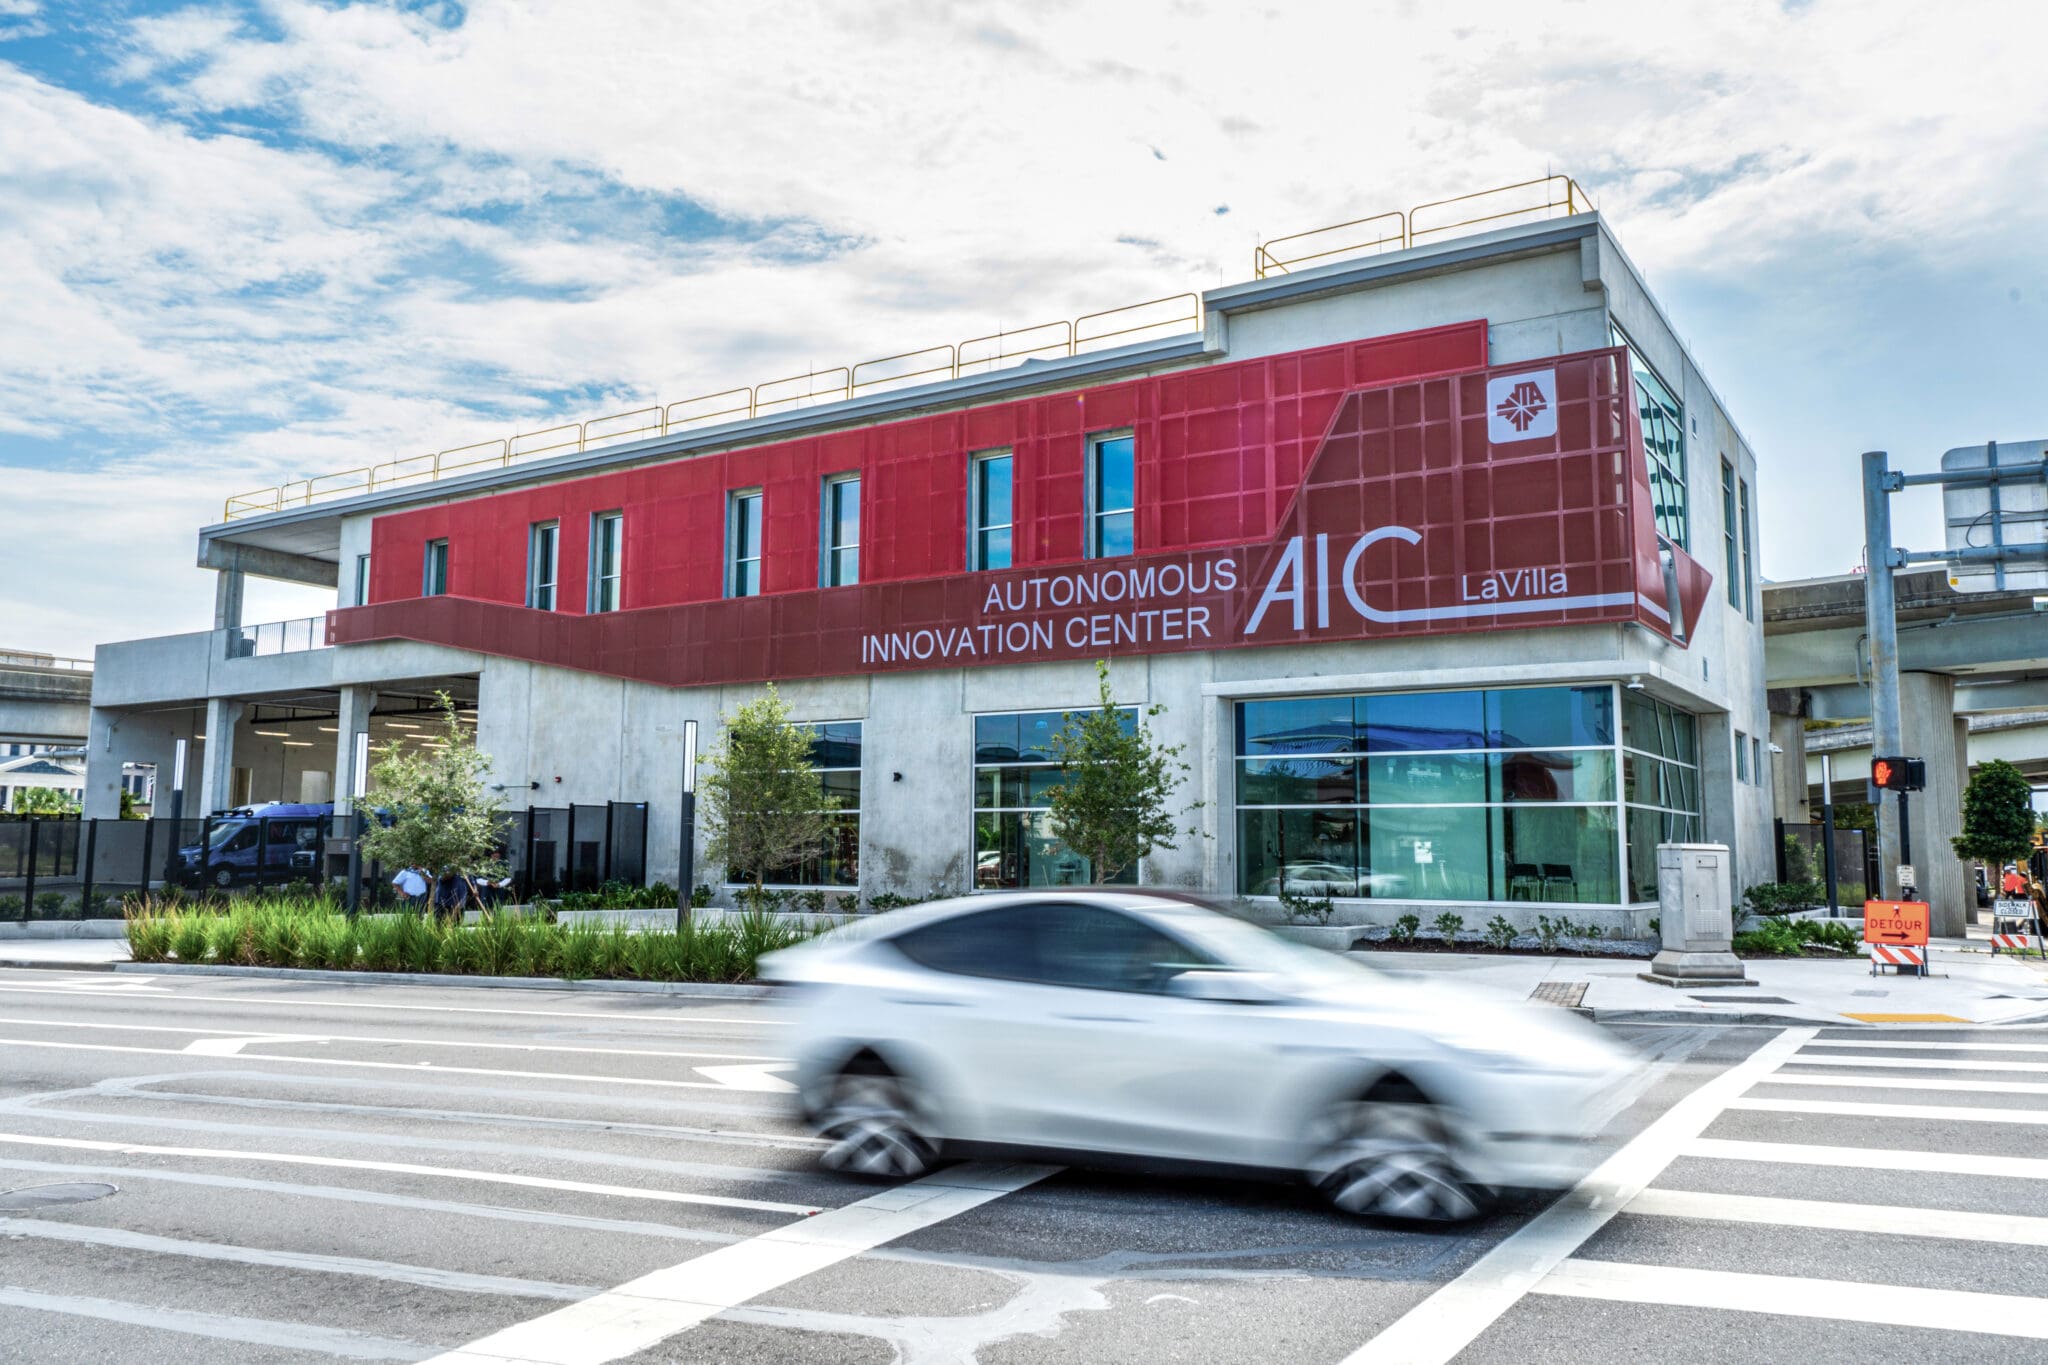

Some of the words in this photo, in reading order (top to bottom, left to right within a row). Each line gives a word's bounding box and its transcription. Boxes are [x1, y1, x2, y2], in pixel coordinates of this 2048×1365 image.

[983, 559, 1237, 613] AUTONOMOUS
[1243, 525, 1423, 634] AIC
[1463, 568, 1568, 601] LaVilla
[862, 619, 1054, 663] INNOVATION
[1066, 607, 1212, 648] CENTER
[1870, 918, 1922, 930] DETOUR
